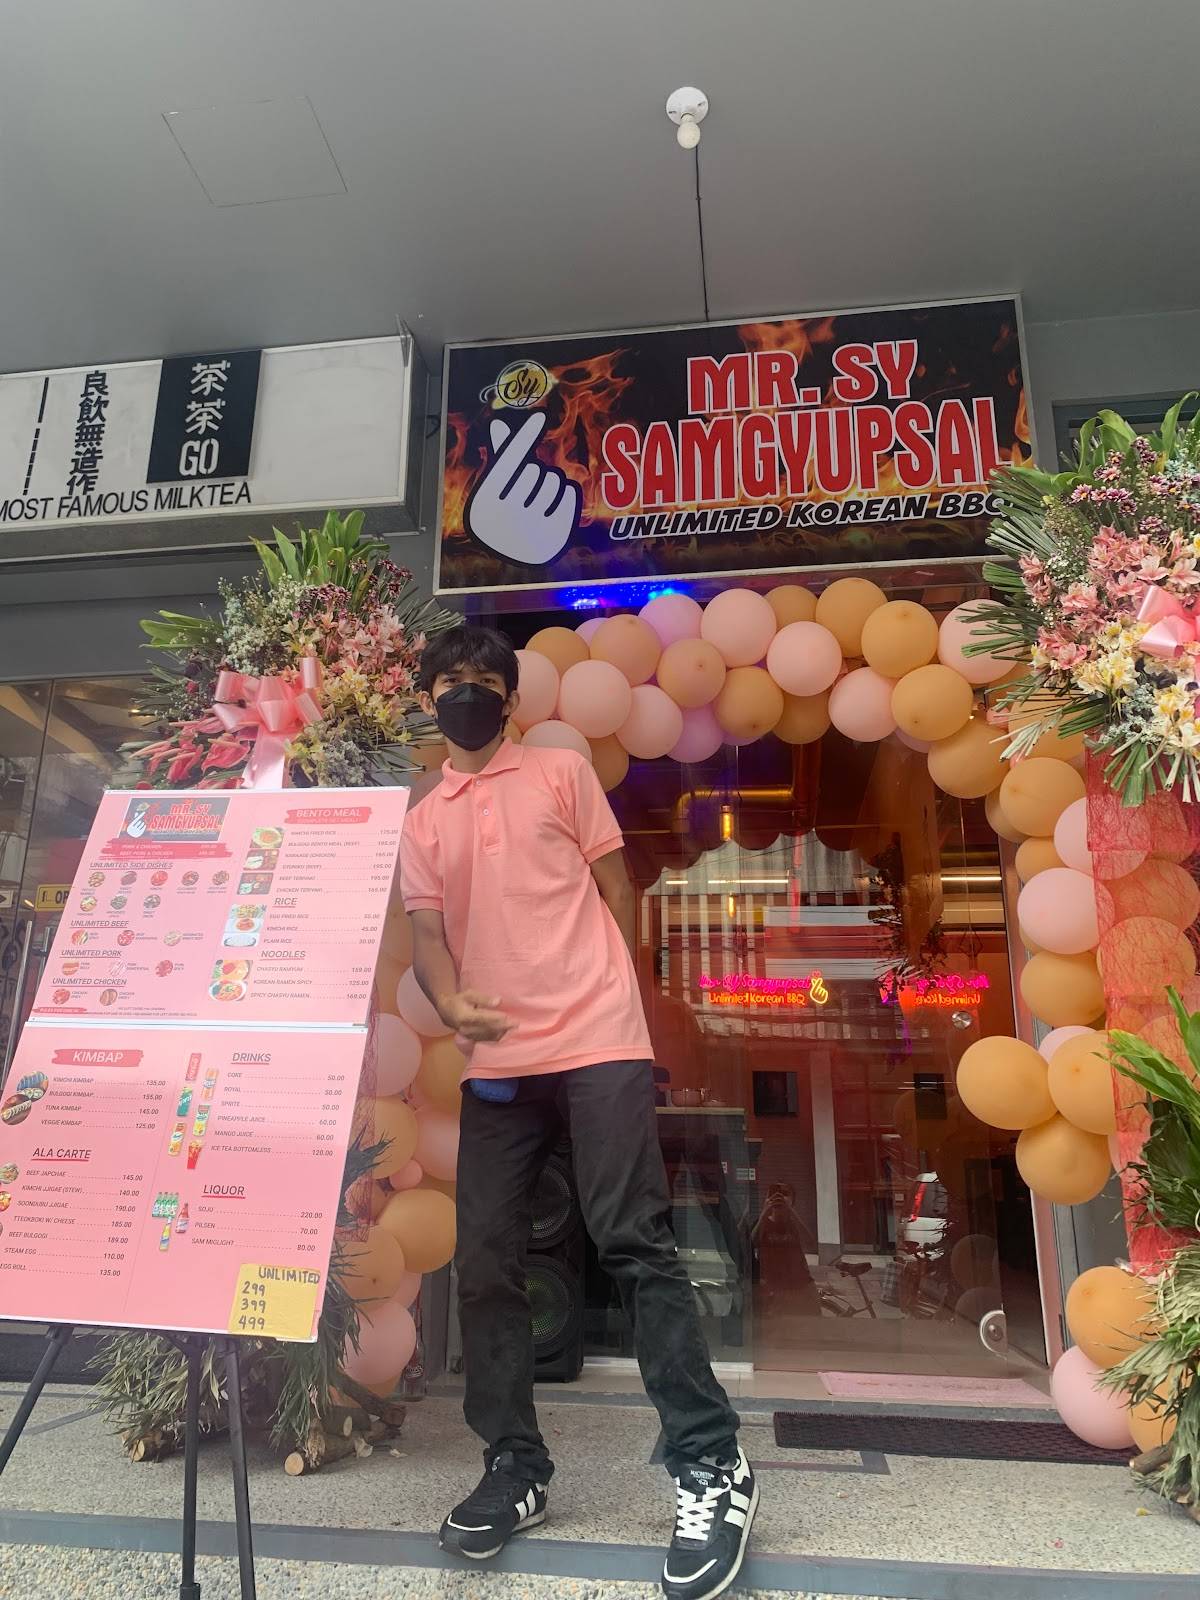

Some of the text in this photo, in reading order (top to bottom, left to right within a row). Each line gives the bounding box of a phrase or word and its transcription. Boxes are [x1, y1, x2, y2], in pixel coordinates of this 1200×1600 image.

[687, 340, 917, 415] MR. SY
[179, 438, 219, 476] GO
[601, 397, 1012, 510] SAMGYUPSAL
[57, 489, 148, 518] FAMOUS
[153, 482, 251, 510] MILKTEA
[609, 506, 781, 541] UNLIMITED
[788, 494, 927, 528] KOREAN
[296, 808, 362, 817] BENTO MEAL
[150, 815, 222, 830] SAMGYUPSAL
[274, 897, 298, 906] RICE
[73, 1051, 124, 1063] KIMBAP
[232, 1052, 271, 1062] DRINKS
[32, 1147, 92, 1159] ALA CARTE
[203, 1184, 245, 1196] LIQUOR
[300, 1211, 323, 1219] 220.00
[297, 1244, 316, 1252] 80.00
[100, 1269, 121, 1277] 135.00
[258, 1266, 321, 1285] UNLIMITED
[241, 1281, 266, 1297] 299
[240, 1298, 266, 1313] 399
[238, 1315, 265, 1330] 499
